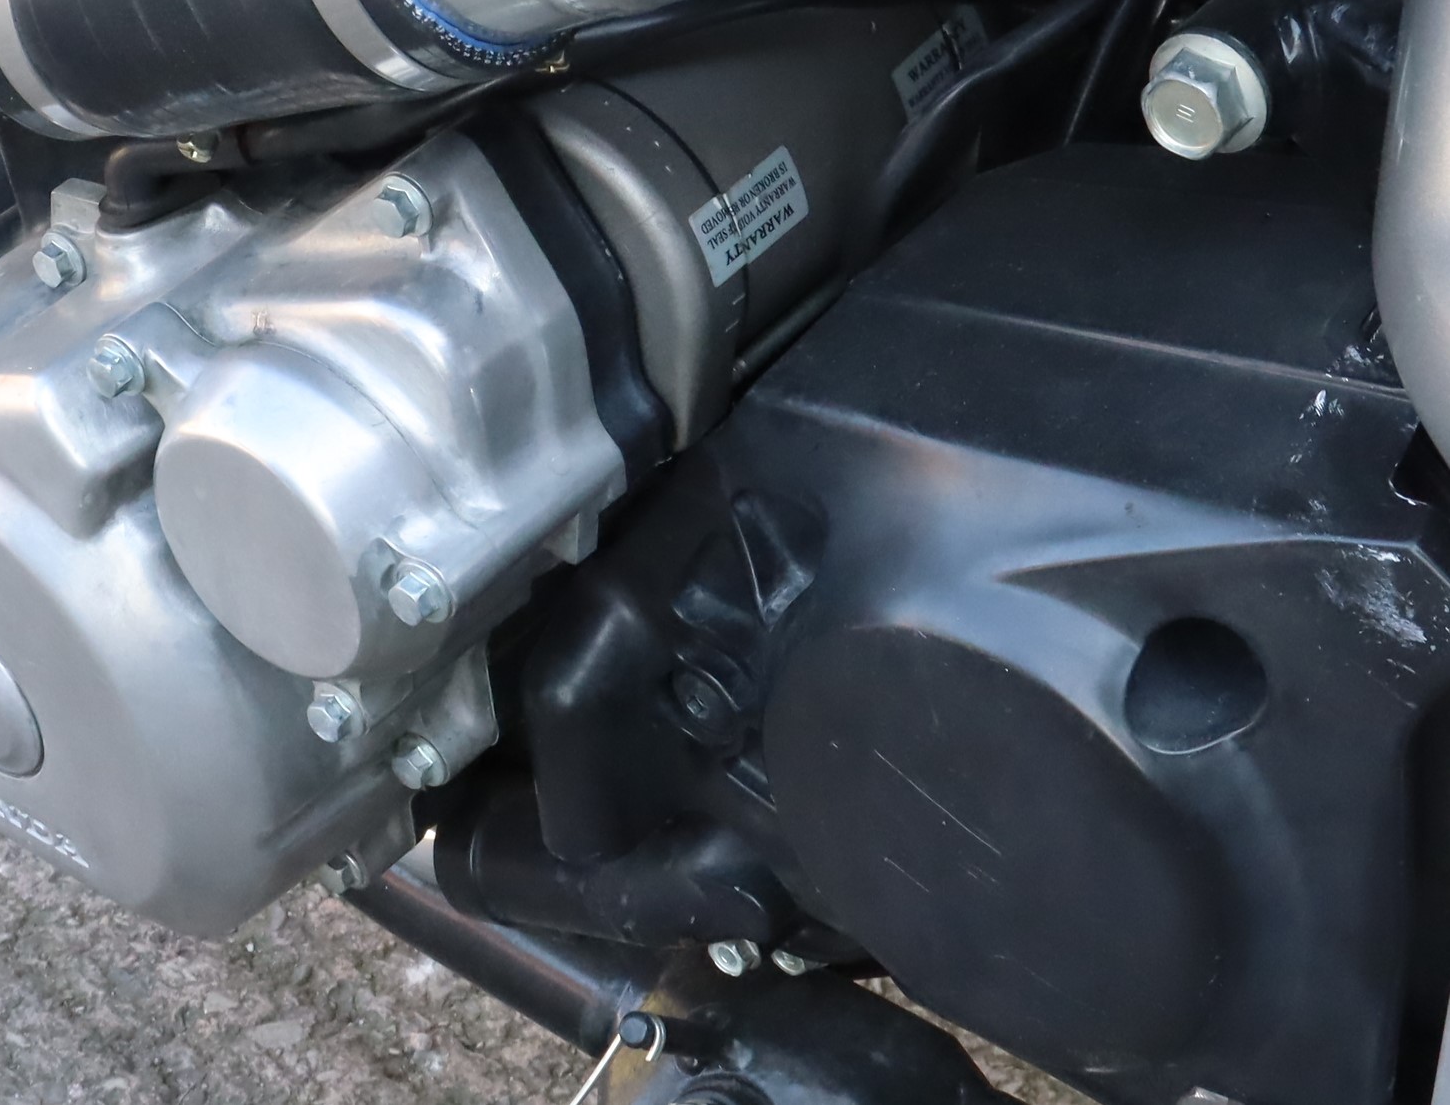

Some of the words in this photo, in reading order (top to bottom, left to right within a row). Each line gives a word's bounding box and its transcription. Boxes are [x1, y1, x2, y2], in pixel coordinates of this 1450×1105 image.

[777, 161, 788, 175] IS
[749, 170, 781, 200] BROKEN
[754, 176, 796, 216] WARRANTY
[738, 193, 751, 207] OR
[707, 228, 728, 250] SEAL
[725, 202, 795, 266] WARRANTY
